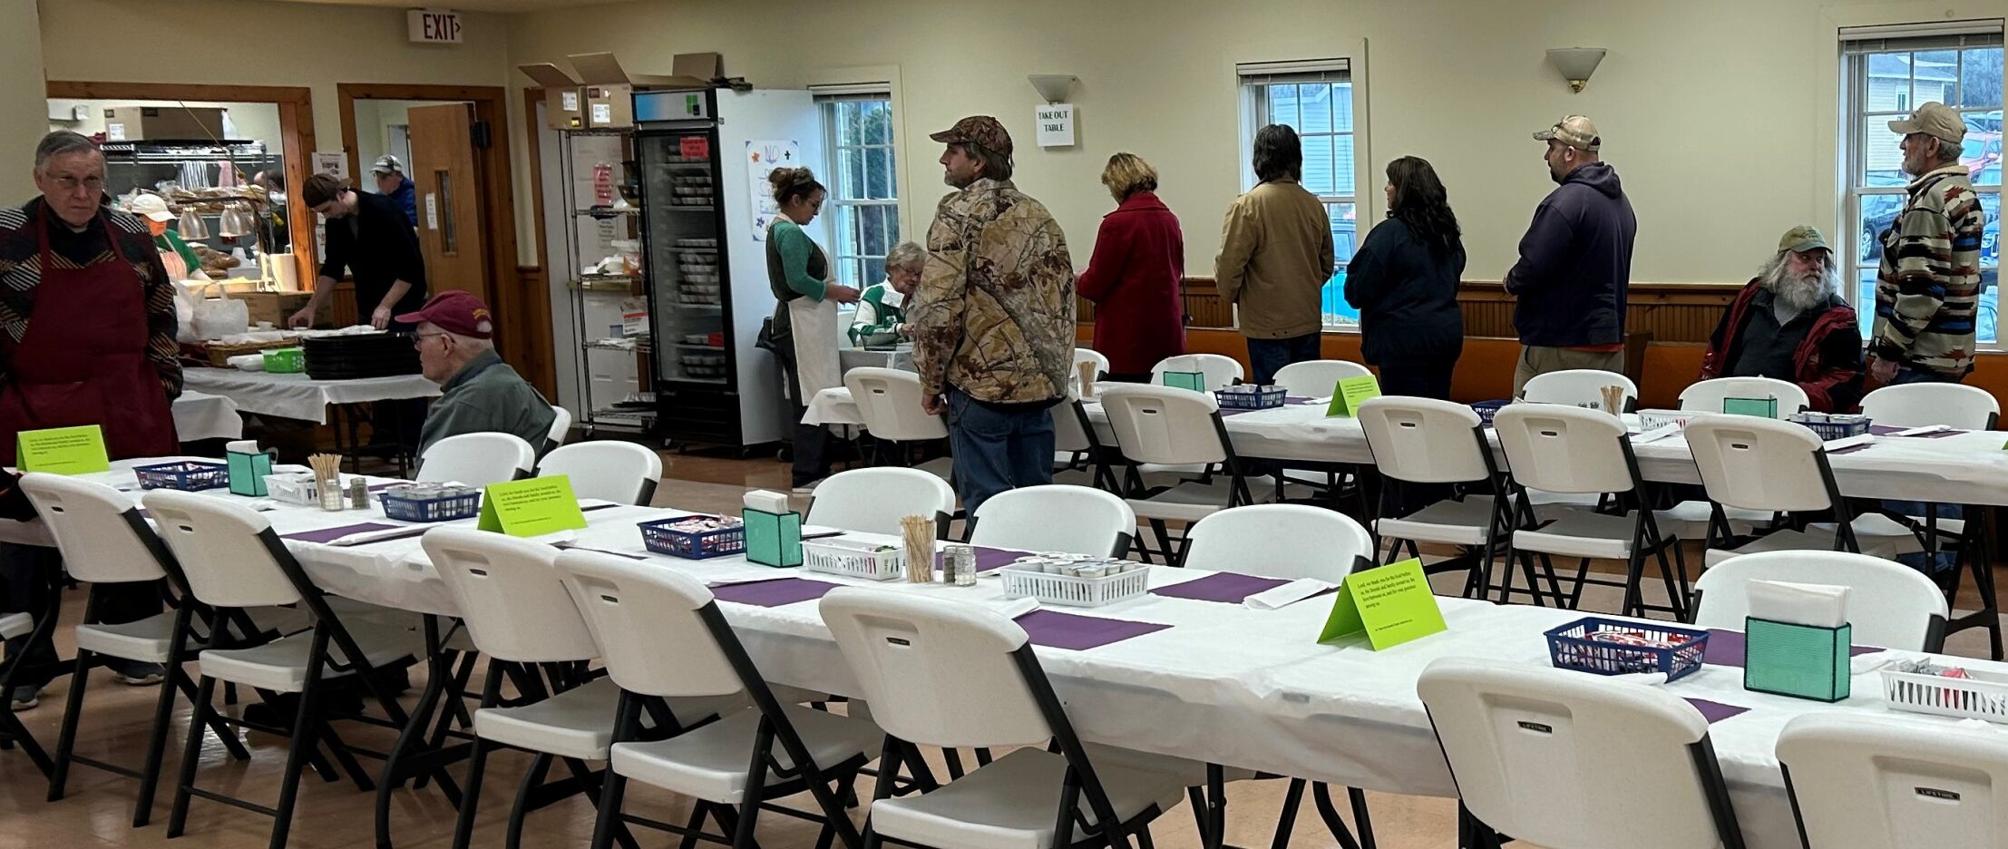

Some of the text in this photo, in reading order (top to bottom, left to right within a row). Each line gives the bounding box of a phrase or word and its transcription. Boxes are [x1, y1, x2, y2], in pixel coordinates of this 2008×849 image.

[423, 14, 456, 40] EXIT
[1038, 110, 1068, 120] TAKE OUT
[1044, 123, 1065, 132] TABLE
